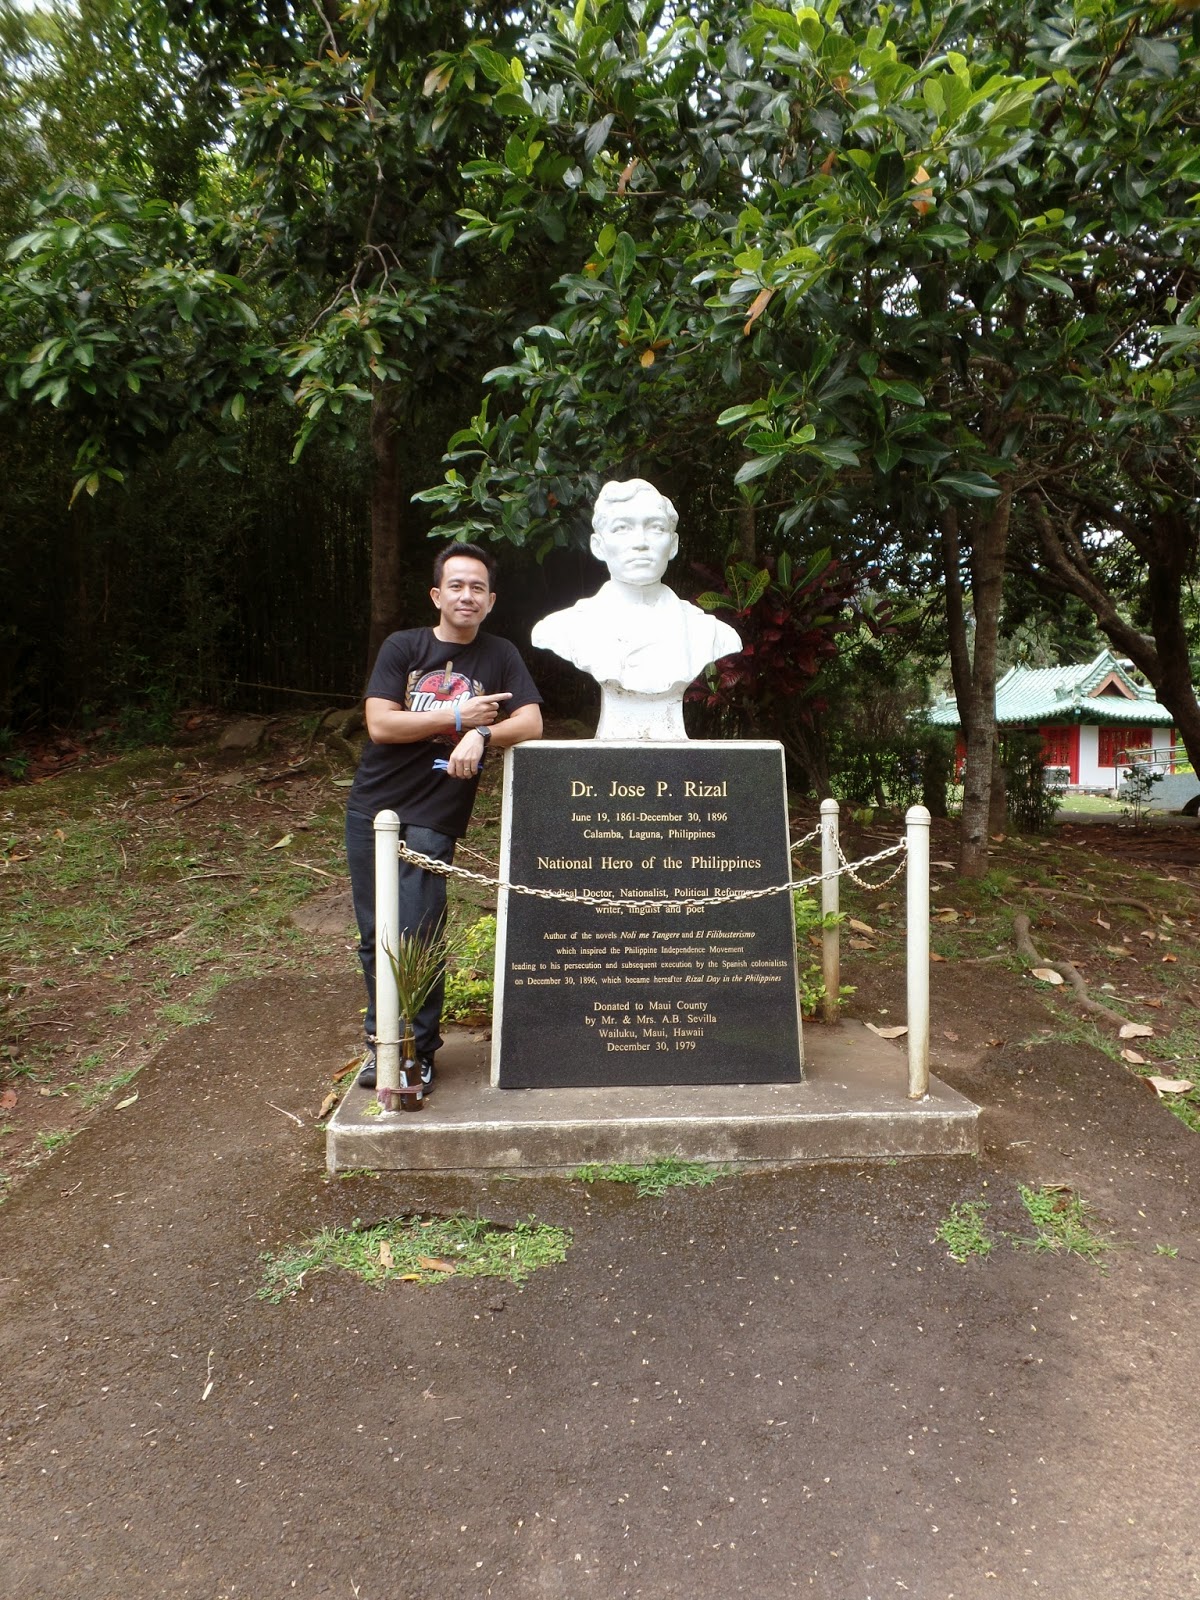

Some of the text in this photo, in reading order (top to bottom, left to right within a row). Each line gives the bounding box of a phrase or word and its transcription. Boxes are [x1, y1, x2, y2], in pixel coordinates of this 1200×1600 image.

[571, 781, 728, 797] Dr. Jose P. Rizal
[571, 813, 727, 822] June 19, 1861-December 30, 1896
[583, 830, 715, 840] Calamba, Laguna, Philippines
[537, 857, 761, 871] National Hero of the Philippines
[583, 888, 615, 899] Doctor,
[620, 888, 668, 898] Nationalist,
[674, 888, 708, 897] Political
[596, 905, 624, 915] writer,
[665, 905, 681, 914] and
[687, 905, 705, 915] poet
[620, 931, 636, 939] Noli
[652, 931, 680, 940] Tangere
[580, 947, 606, 956] inspired
[624, 946, 657, 955] Philippine
[661, 946, 705, 955] Independence
[710, 946, 744, 954] Movement
[512, 962, 536, 971] leading
[564, 961, 602, 970] persecution
[606, 961, 617, 969] and
[621, 961, 657, 970] subsequent
[696, 961, 705, 970] by
[708, 960, 718, 968] the
[722, 960, 747, 969] Spanish
[527, 977, 561, 985] December
[564, 977, 575, 986] 30,
[580, 977, 597, 985] 1896,
[601, 976, 621, 984] which
[625, 976, 650, 984] became
[706, 975, 720, 985] Day
[745, 974, 781, 983] Philippines
[594, 1001, 708, 1012] Donated to Maui County
[585, 1014, 717, 1026] by Mr. & Mrs. A.B. Sevilla
[599, 1028, 704, 1039] Wailuku, Maui, Hawaii
[607, 1041, 696, 1052] December 30, 1979
